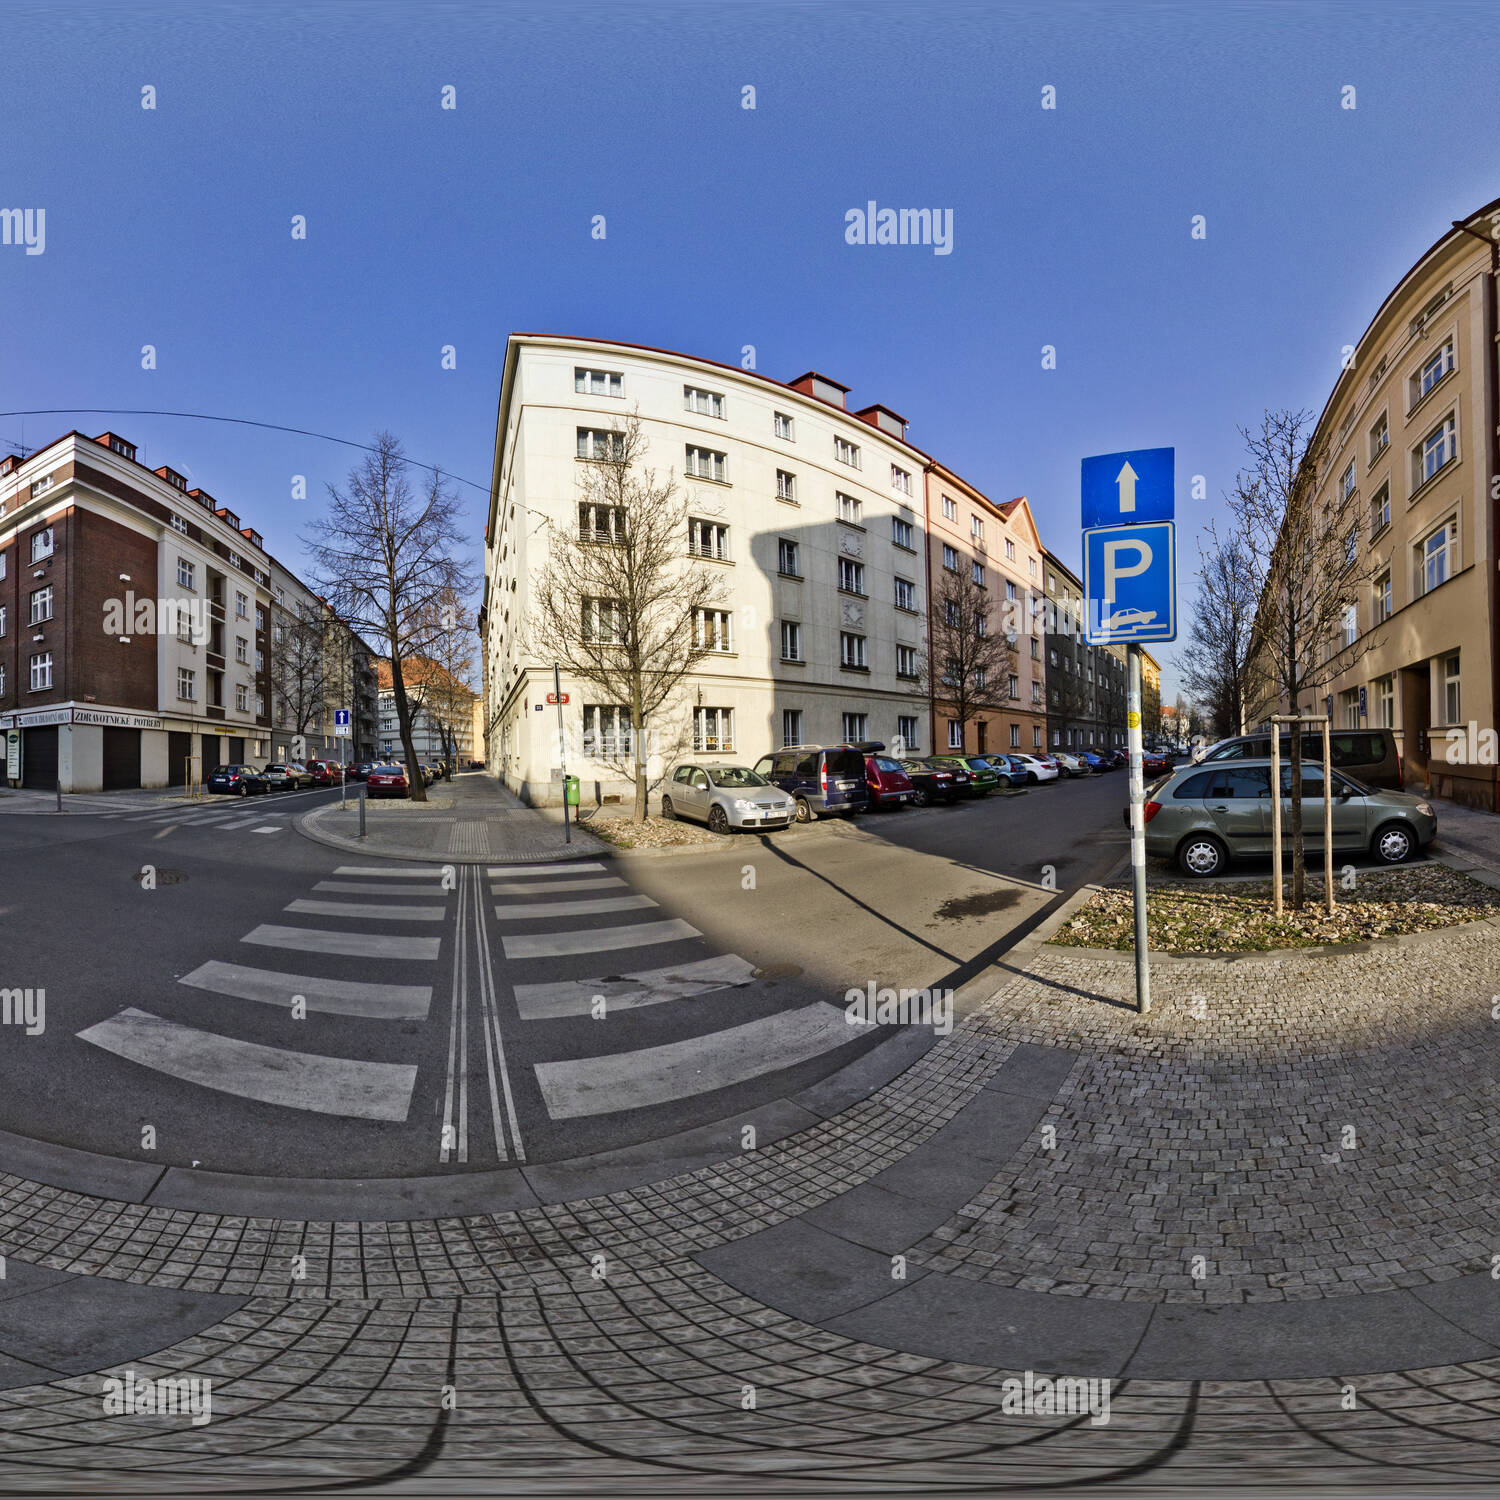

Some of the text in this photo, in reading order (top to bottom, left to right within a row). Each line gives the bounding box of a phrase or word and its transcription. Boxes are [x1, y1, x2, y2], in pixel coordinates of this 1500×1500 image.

[1104, 539, 1153, 604] P
[75, 711, 161, 728] ZDRAVOTNICKÉ POTŘEBY
